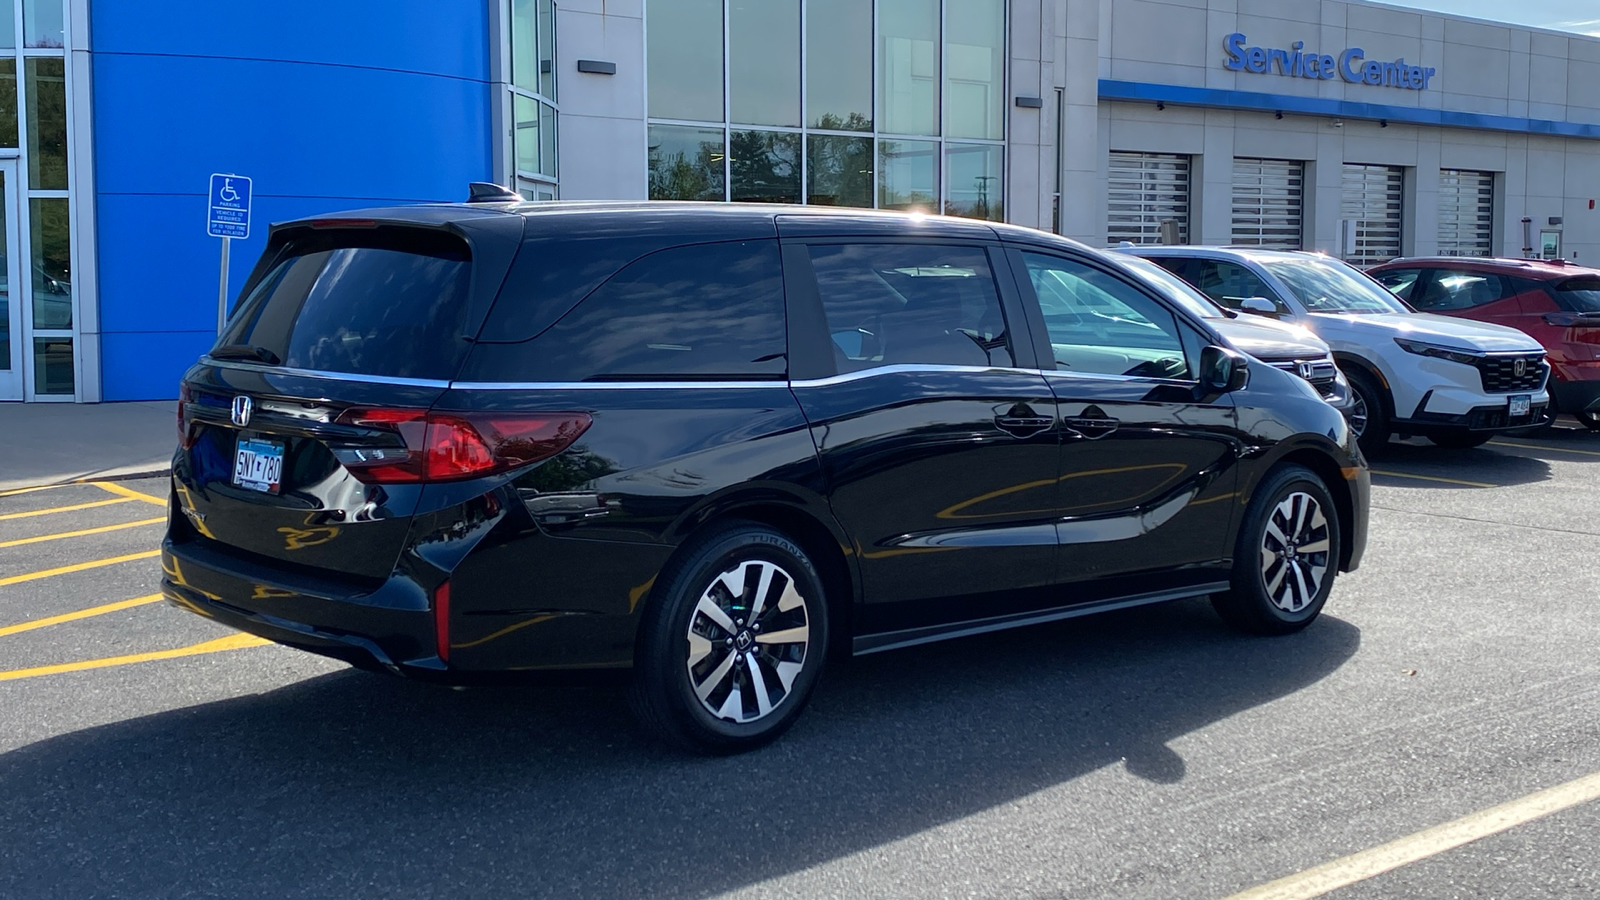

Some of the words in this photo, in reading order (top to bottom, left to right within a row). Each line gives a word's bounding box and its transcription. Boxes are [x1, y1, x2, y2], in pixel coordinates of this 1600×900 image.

[1223, 33, 1335, 80] Service
[1338, 48, 1436, 89] Center
[237, 452, 256, 477] SNY
[262, 456, 280, 481] 780
